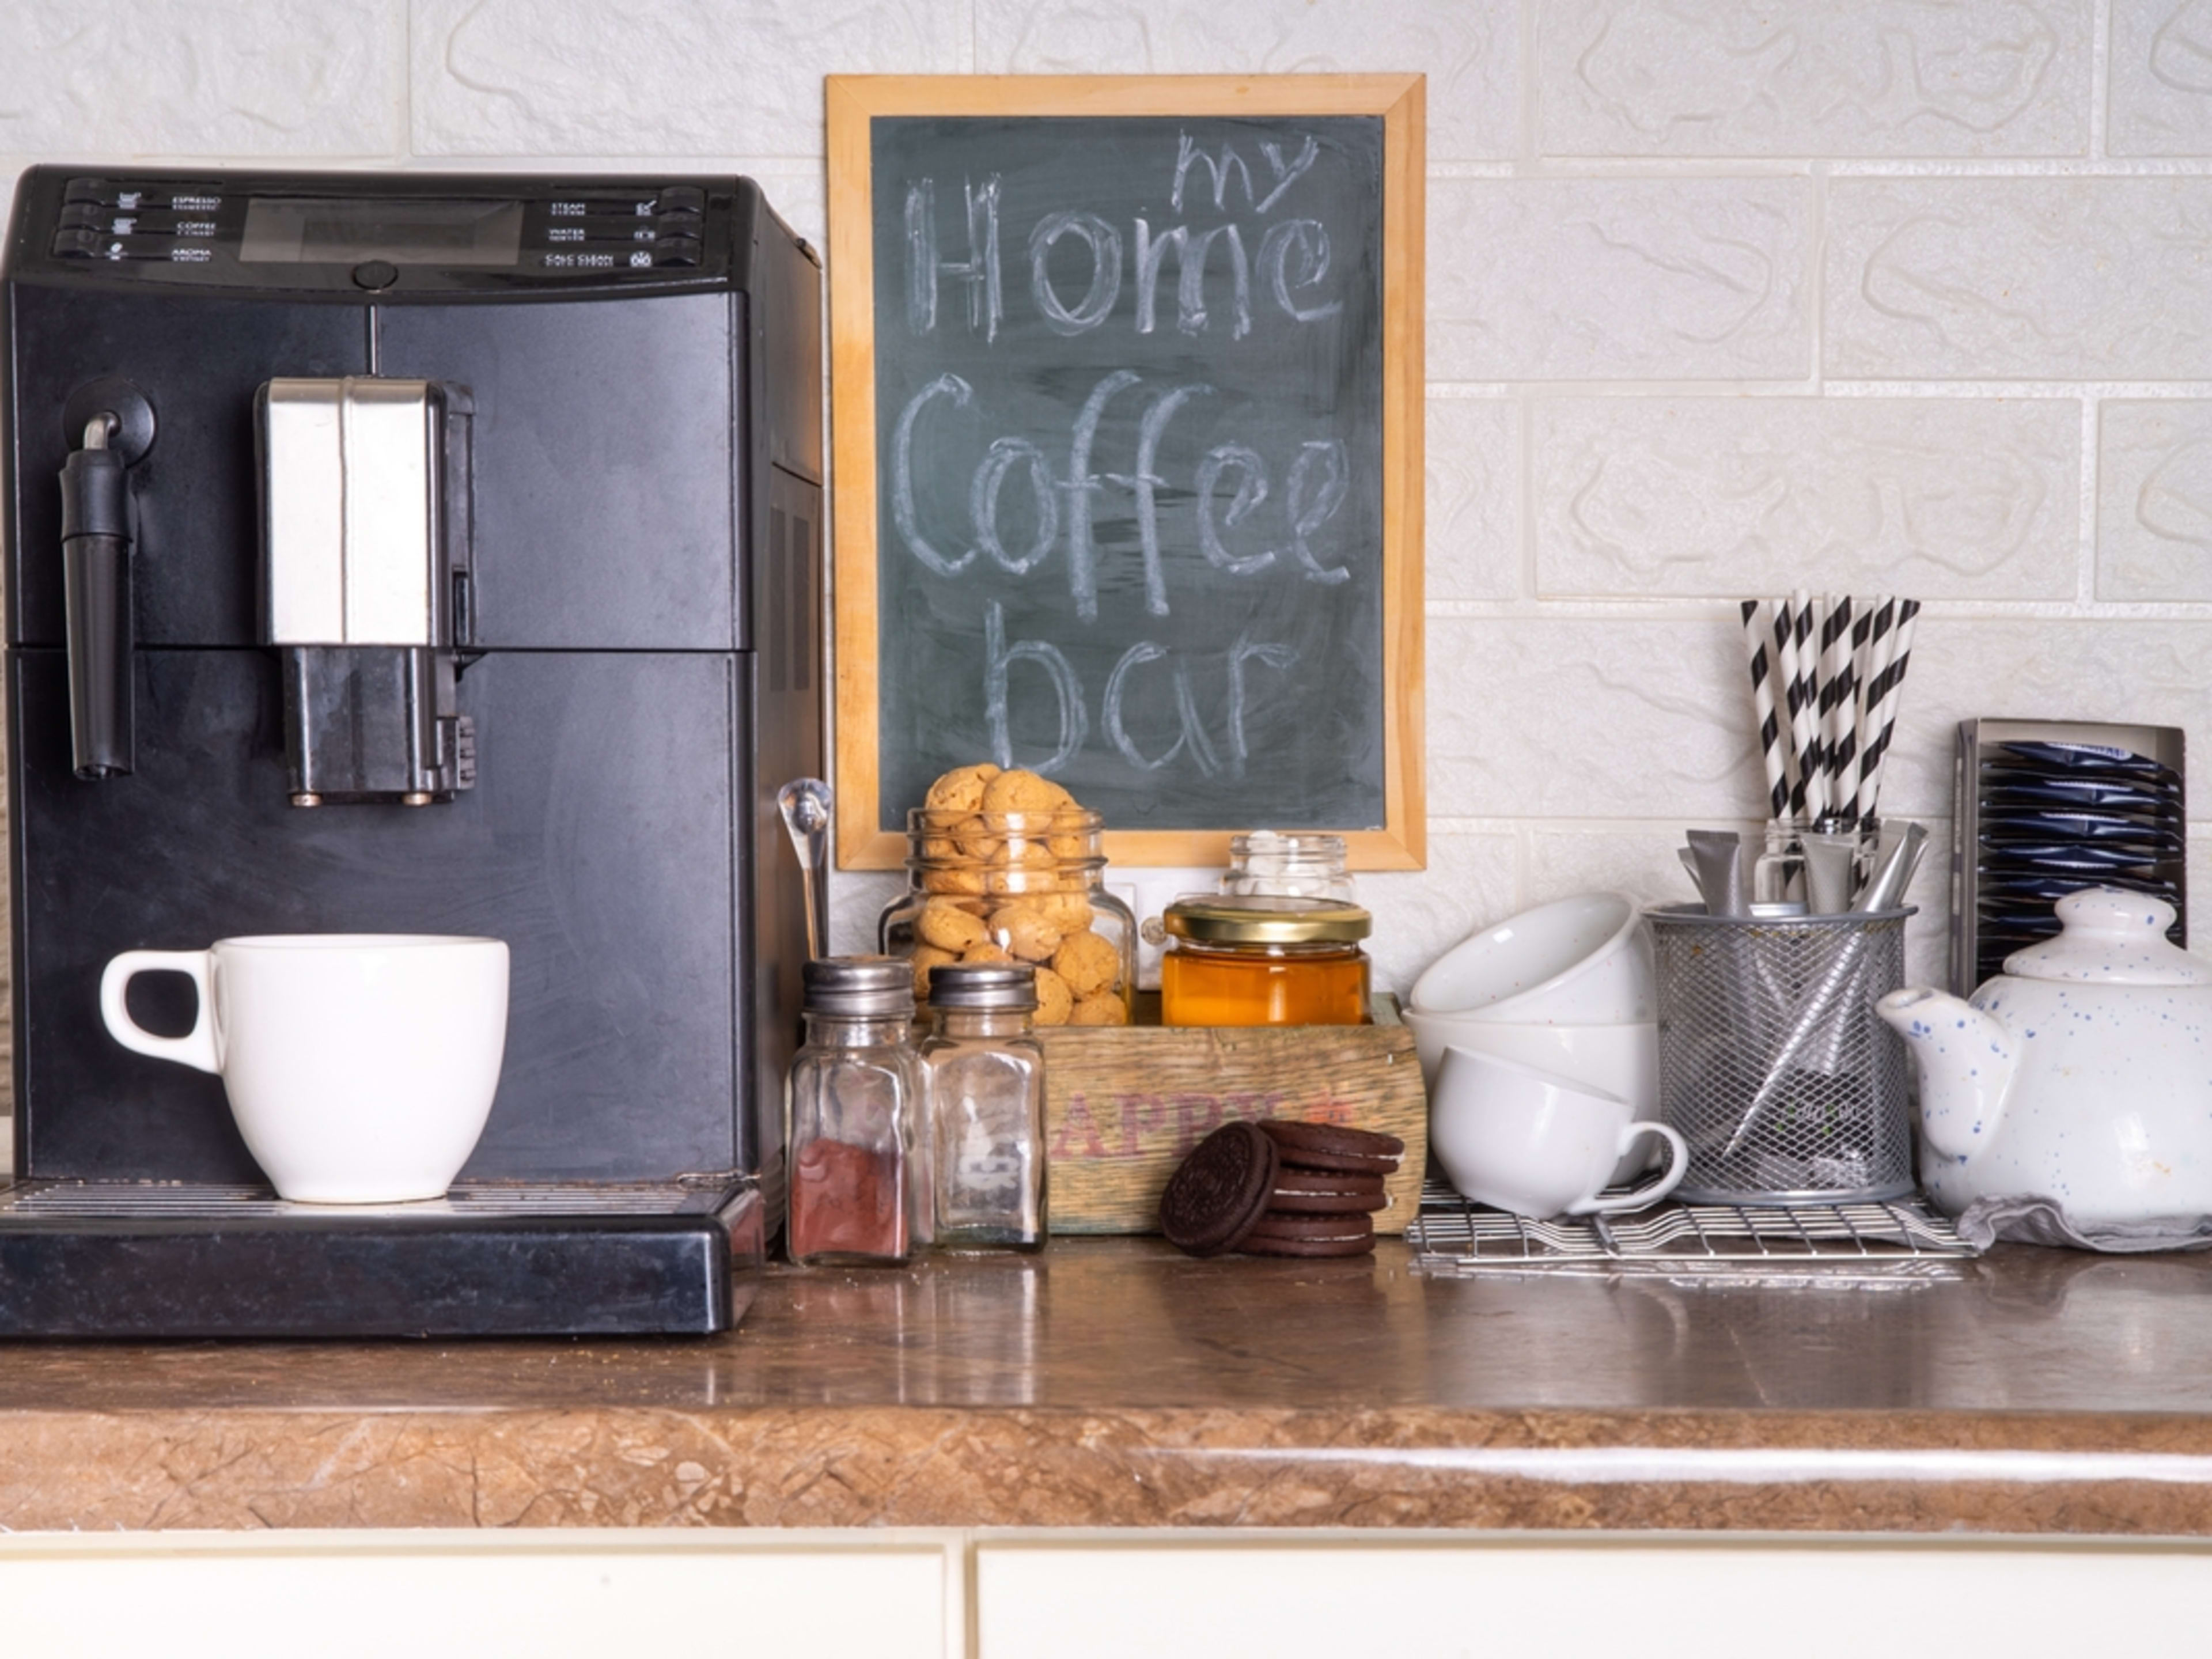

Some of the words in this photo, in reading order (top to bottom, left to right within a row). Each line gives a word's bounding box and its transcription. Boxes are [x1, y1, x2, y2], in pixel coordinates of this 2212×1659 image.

[172, 196, 222, 205] ESPRESSO
[177, 222, 216, 231] COFFEE
[172, 248, 211, 257] AROMA
[904, 172, 1344, 342] Home
[892, 370, 1351, 623] Coffee
[984, 598, 1301, 780] bar
